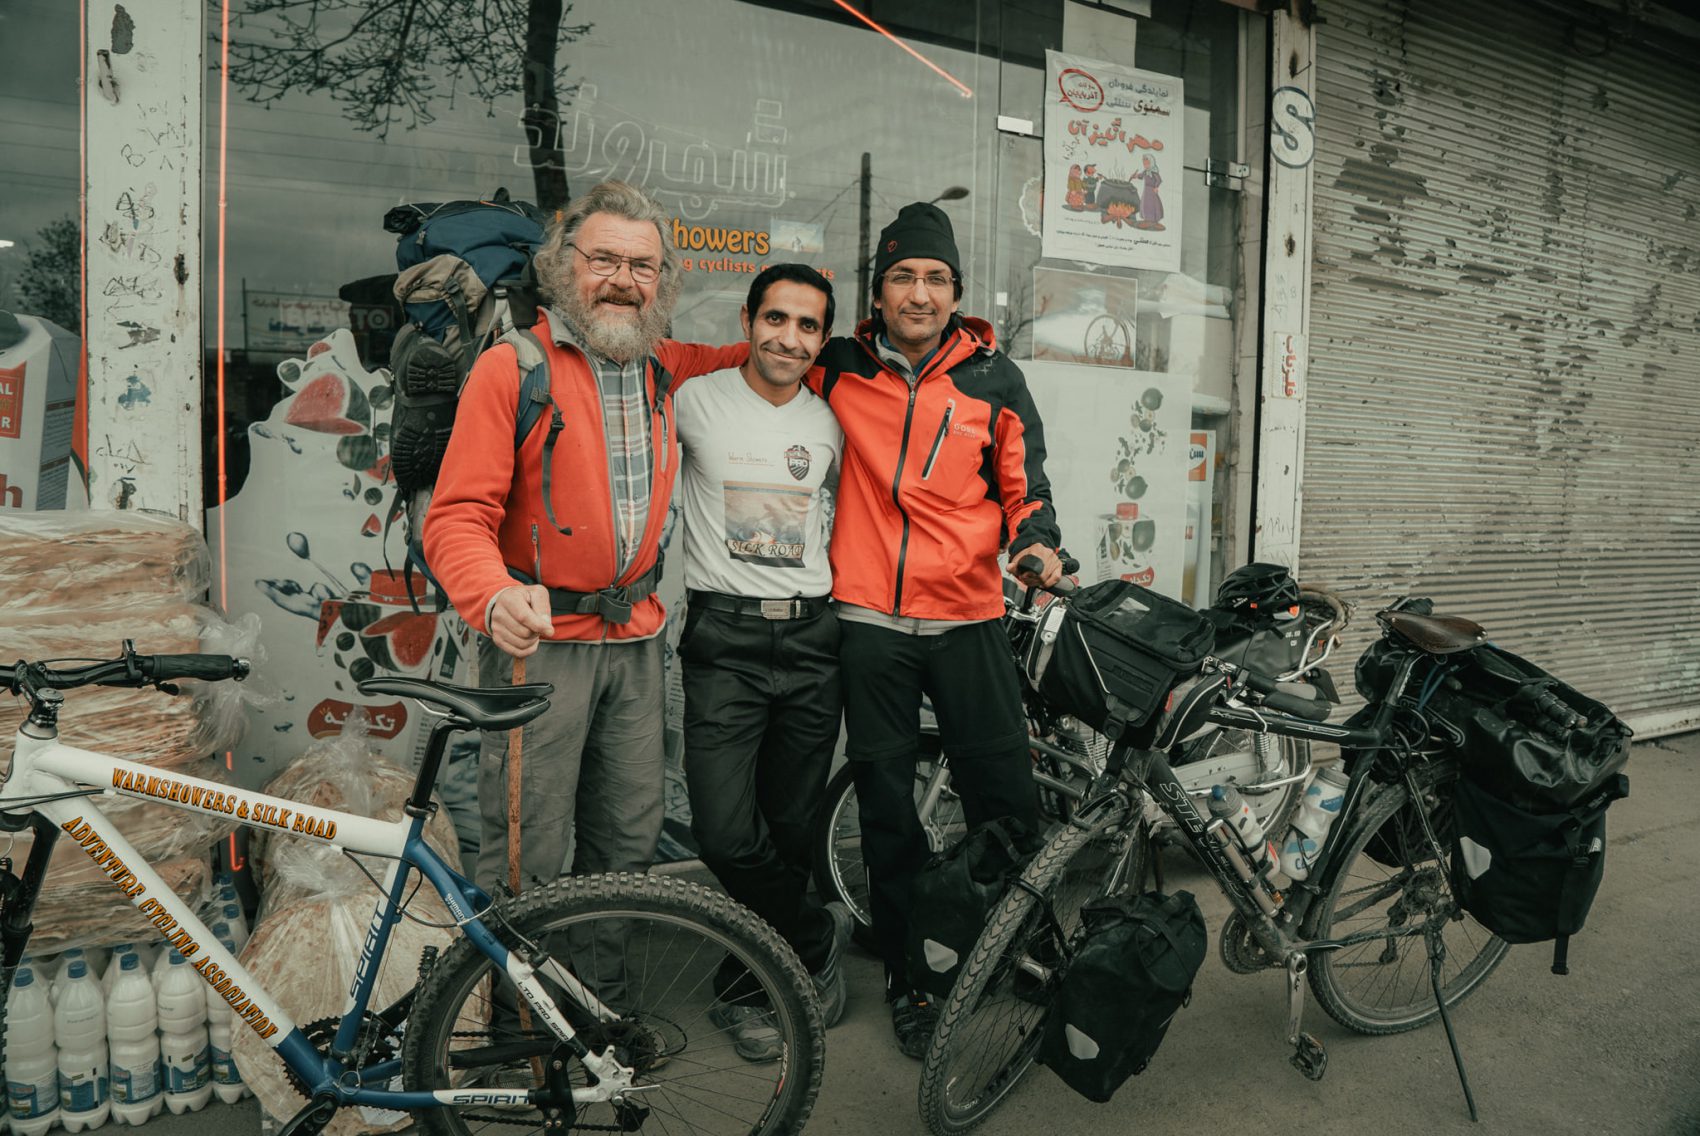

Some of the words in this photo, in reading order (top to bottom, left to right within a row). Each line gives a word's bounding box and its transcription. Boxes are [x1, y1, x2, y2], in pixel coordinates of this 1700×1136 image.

[667, 217, 770, 256] howers
[699, 257, 756, 273] cyclists
[768, 544, 803, 557] ROAD
[111, 766, 236, 816] WARMSHOWERS
[236, 799, 250, 819] &
[251, 801, 292, 828] SILK
[293, 812, 338, 841] ROAD
[62, 815, 145, 900] ADVENTURE
[138, 896, 201, 961] CYCLING
[191, 954, 281, 1040] ASSOCIATION
[453, 1094, 529, 1105] SPIRIT
